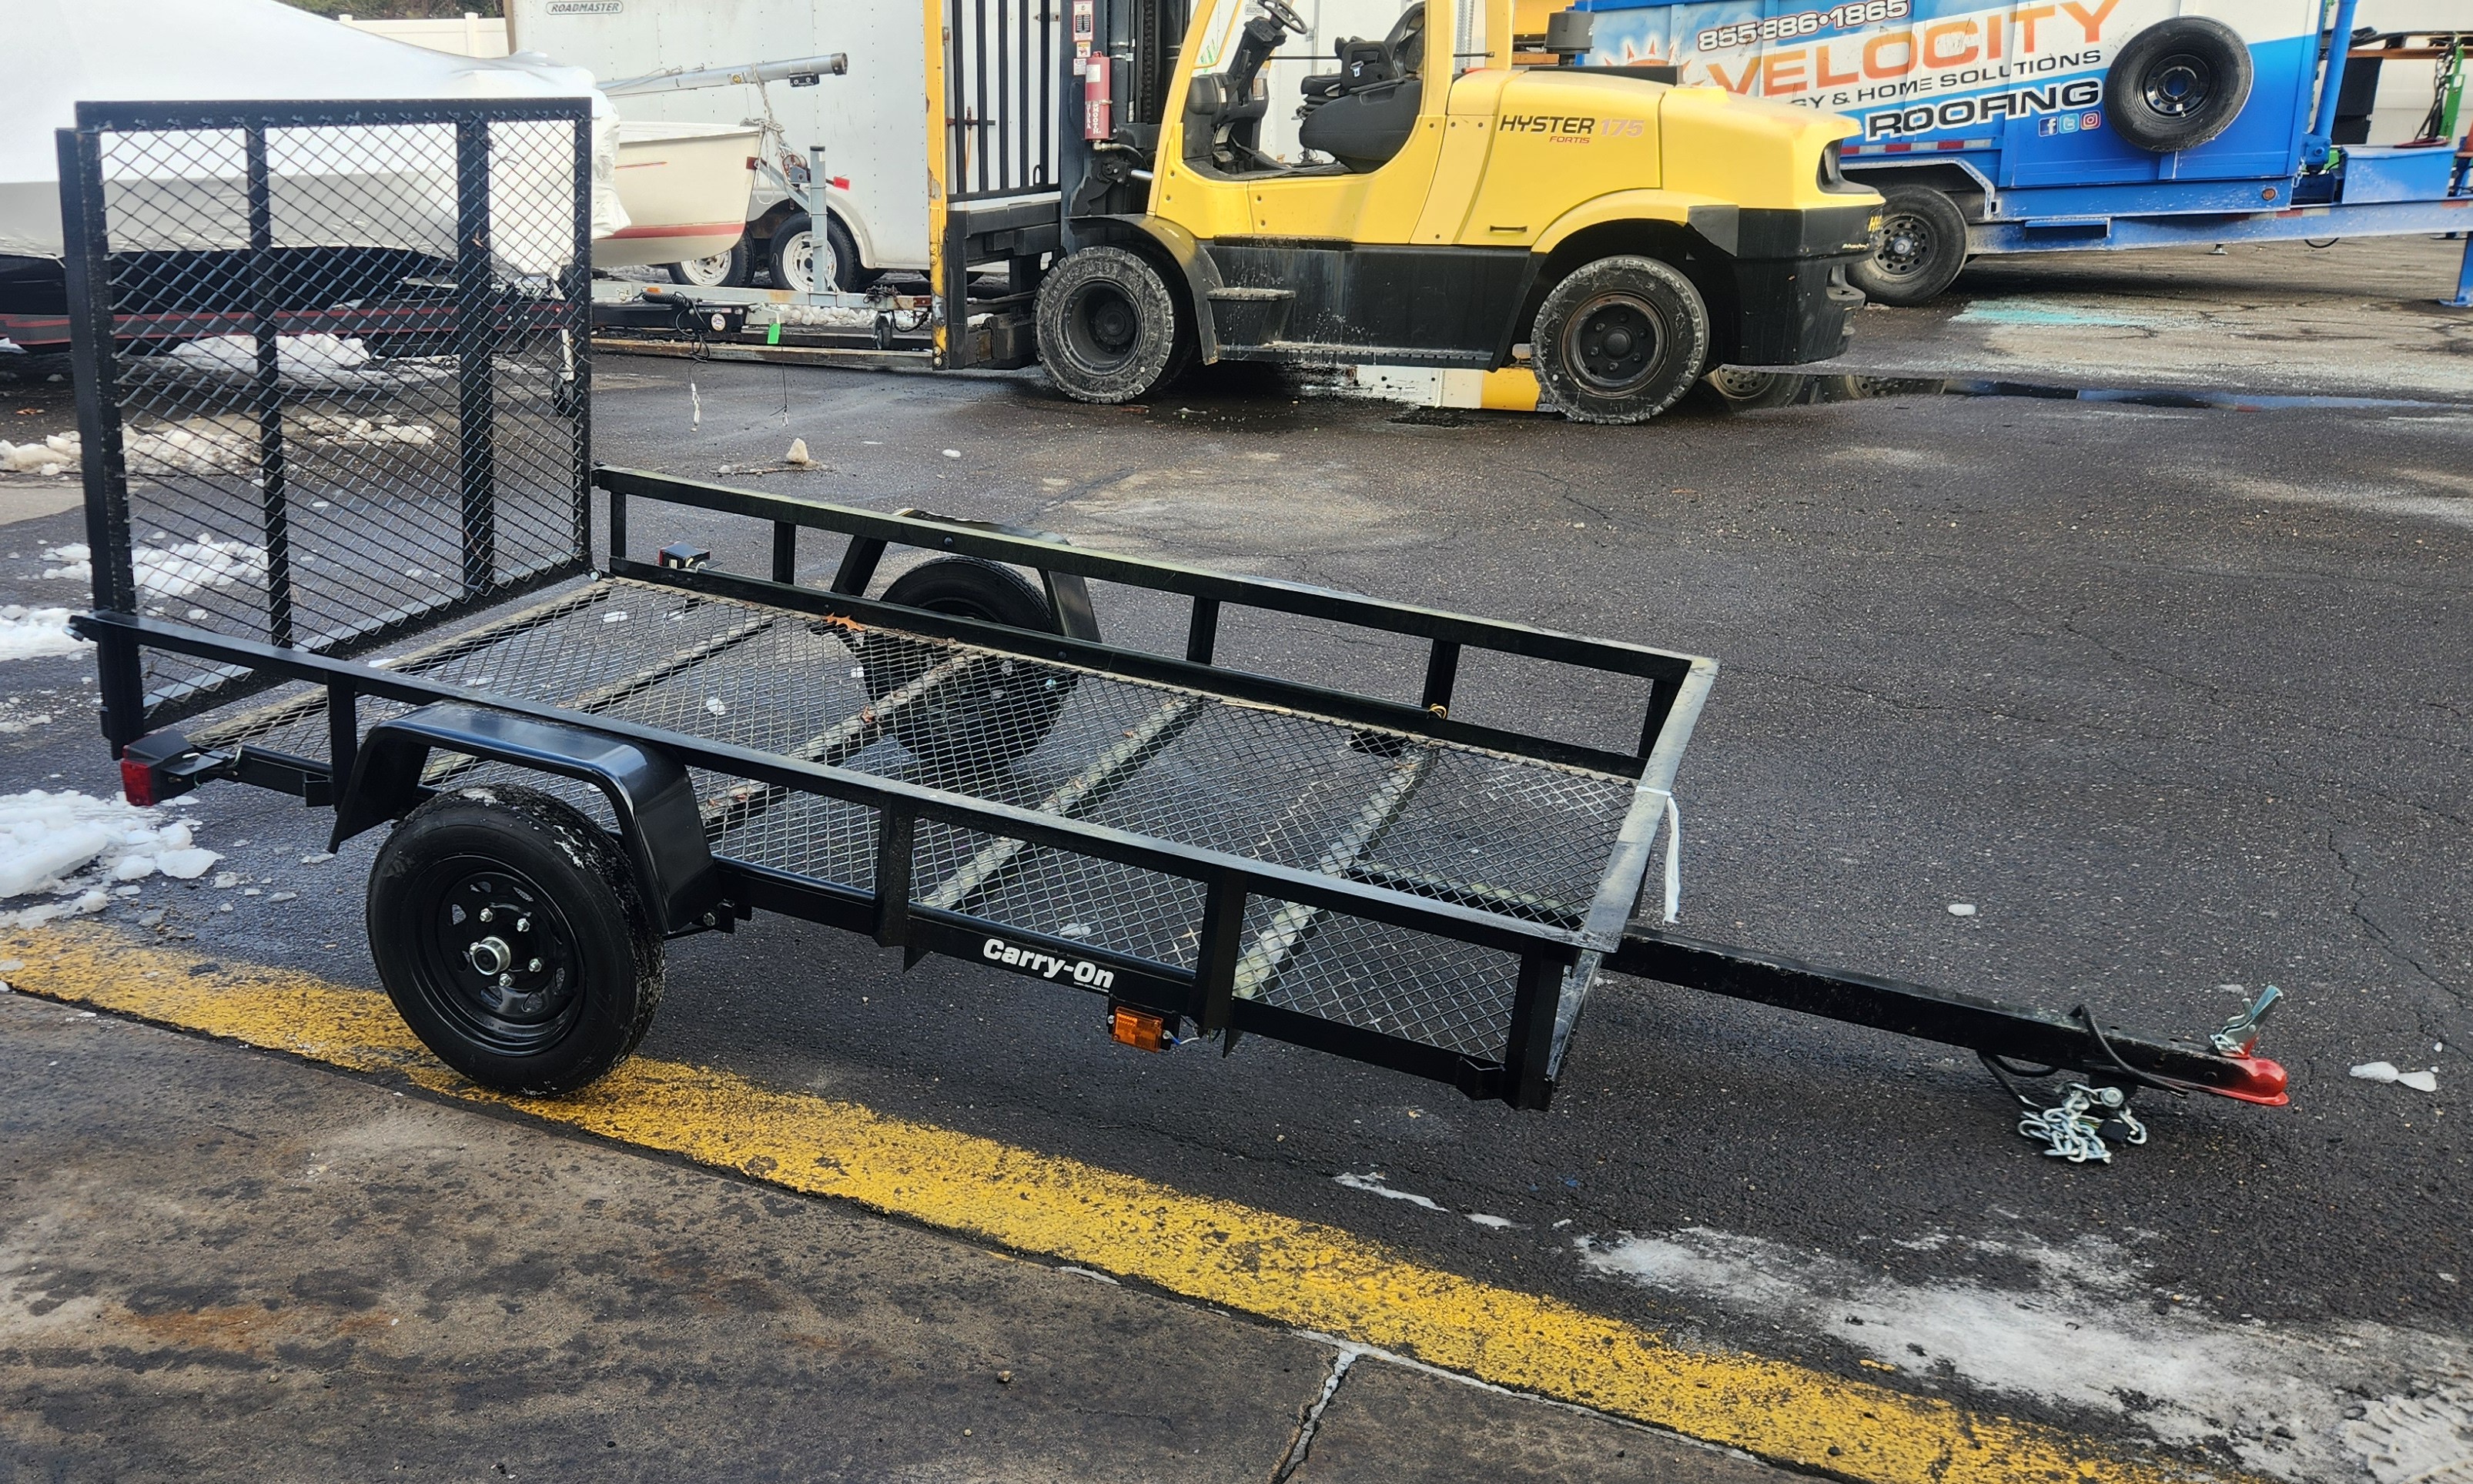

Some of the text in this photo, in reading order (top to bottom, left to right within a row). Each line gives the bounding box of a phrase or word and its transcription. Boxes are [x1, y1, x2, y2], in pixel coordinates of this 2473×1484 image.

[551, 3, 619, 12] ROADMASTER
[1706, 0, 2117, 96] VELOCITY
[1832, 92, 1850, 105] &
[1858, 77, 1933, 102] HOME
[1940, 50, 2101, 88] SOLUTIONS
[1499, 115, 1645, 137] HYSTER 175
[1866, 79, 2101, 141] ROOFING
[1549, 135, 1591, 144] FORTIS
[983, 938, 1115, 988] Carry-On
